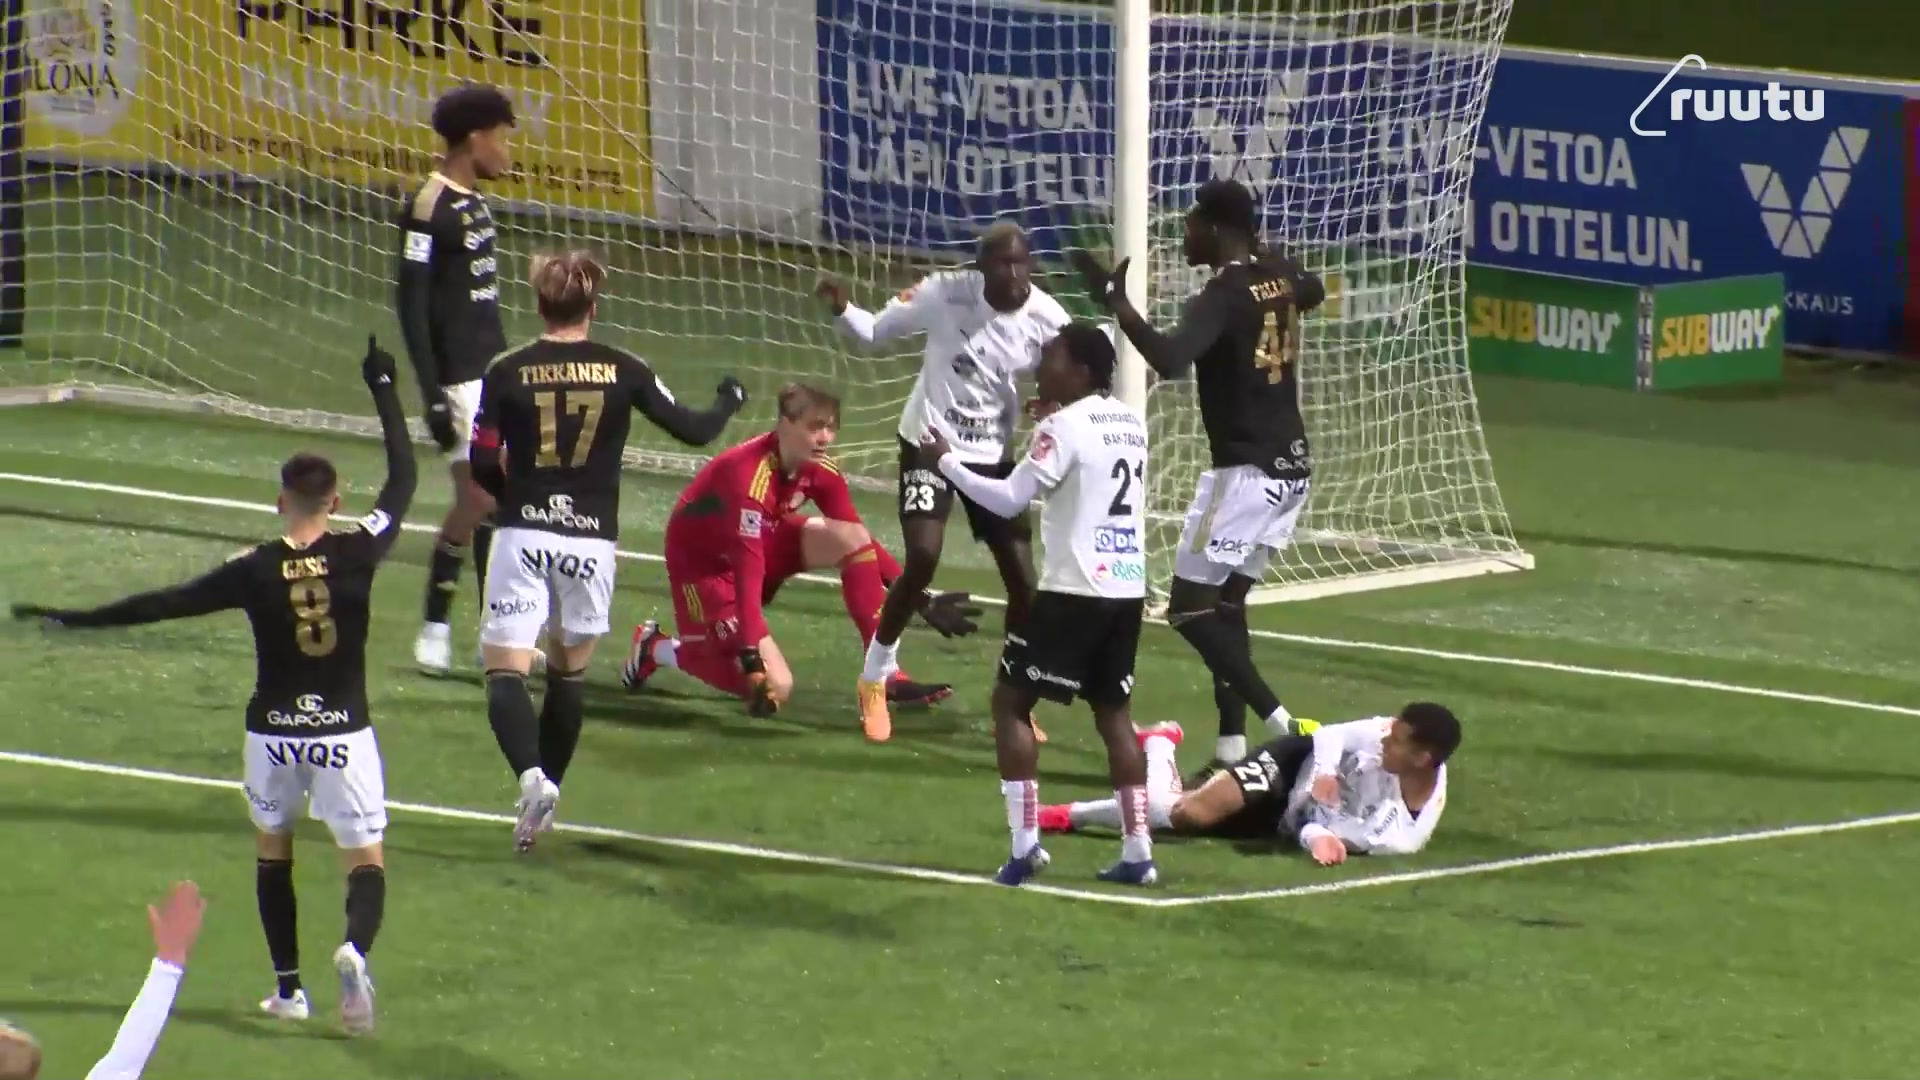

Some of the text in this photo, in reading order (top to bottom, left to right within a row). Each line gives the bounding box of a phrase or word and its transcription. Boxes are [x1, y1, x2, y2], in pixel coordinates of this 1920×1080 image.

[957, 143, 1115, 202] OTTELU
[1490, 200, 1704, 272] OTTELUN.
[1468, 296, 1622, 354] SUBWAY
[1657, 304, 1781, 361] SUBWAY
[519, 362, 617, 385] TIKKANEN
[534, 390, 605, 469] 17
[904, 484, 935, 511] 23
[521, 504, 600, 531] GAPCON
[521, 547, 598, 580] NYQS
[289, 577, 337, 658] 8
[266, 709, 349, 728] GAPCON
[265, 741, 350, 769] NYQS
[1233, 761, 1270, 792] 27
